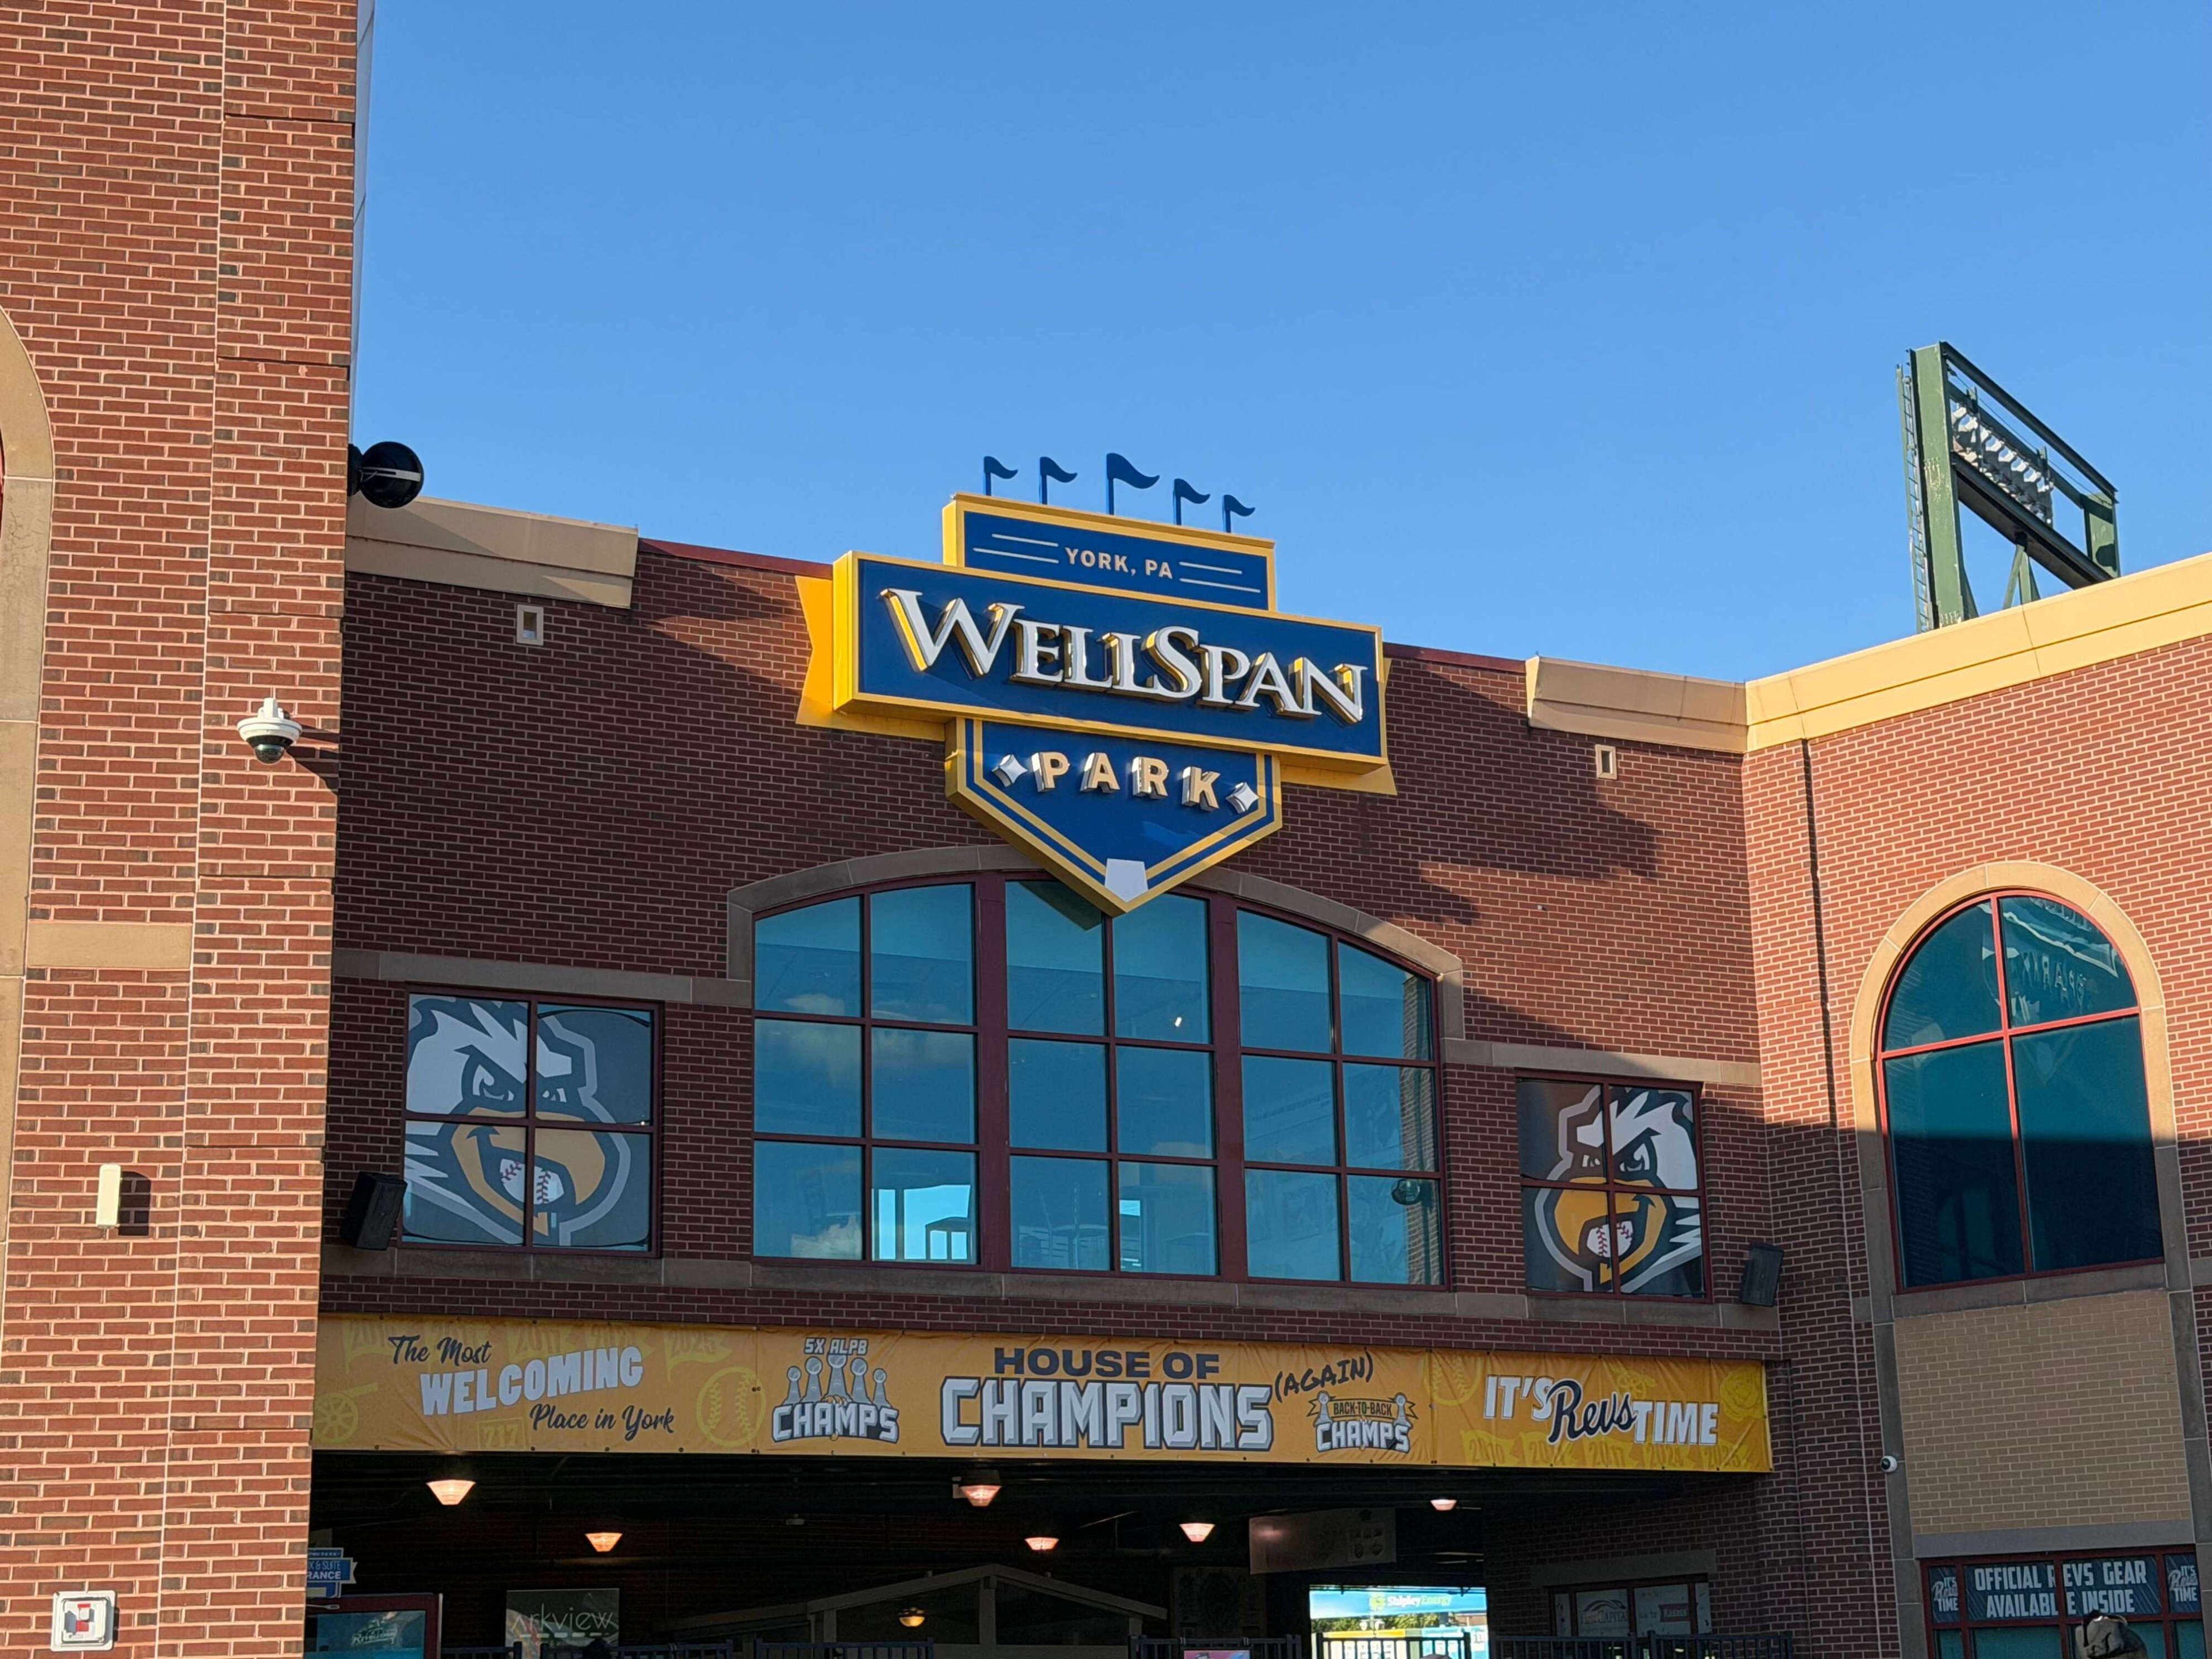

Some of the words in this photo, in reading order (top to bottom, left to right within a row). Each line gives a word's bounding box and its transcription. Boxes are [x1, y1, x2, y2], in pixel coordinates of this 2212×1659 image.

[1064, 546, 1136, 576] YORK,
[1144, 559, 1173, 580] PA
[1032, 751, 1220, 812] PARK
[388, 1335, 430, 1364] The
[436, 1337, 492, 1366] Most
[804, 1338, 826, 1354] 5X
[829, 1339, 868, 1355] ALPB
[994, 1347, 1151, 1378] HOUSE
[1162, 1352, 1220, 1380] OF
[1274, 1351, 1374, 1402] (AGAIN)
[420, 1346, 643, 1416] WELCOMING
[529, 1403, 589, 1432] Place
[595, 1405, 616, 1430] in
[621, 1405, 675, 1441] York
[772, 1401, 899, 1443] CHAMPS
[941, 1376, 1273, 1451] CHAMPIONS
[1333, 1401, 1393, 1417] BACK-TO-BACK
[1483, 1374, 1555, 1420] IT'S
[1546, 1378, 1638, 1445] Revs
[1632, 1400, 1720, 1445] TIME
[1316, 1420, 1411, 1453] CHAMPS
[322, 1561, 341, 1571] SUITE
[1974, 1565, 2042, 1591] OFFICIAL
[2047, 1562, 2094, 1588] REVS
[2103, 1560, 2147, 1585] GEAR
[2180, 1565, 2196, 1575] IT'S
[1937, 1597, 1959, 1612] TIME
[1986, 1590, 2076, 1618] AVAILABLE
[2081, 1589, 2135, 1614] INSIDE
[2173, 1587, 2198, 1602] TIME
